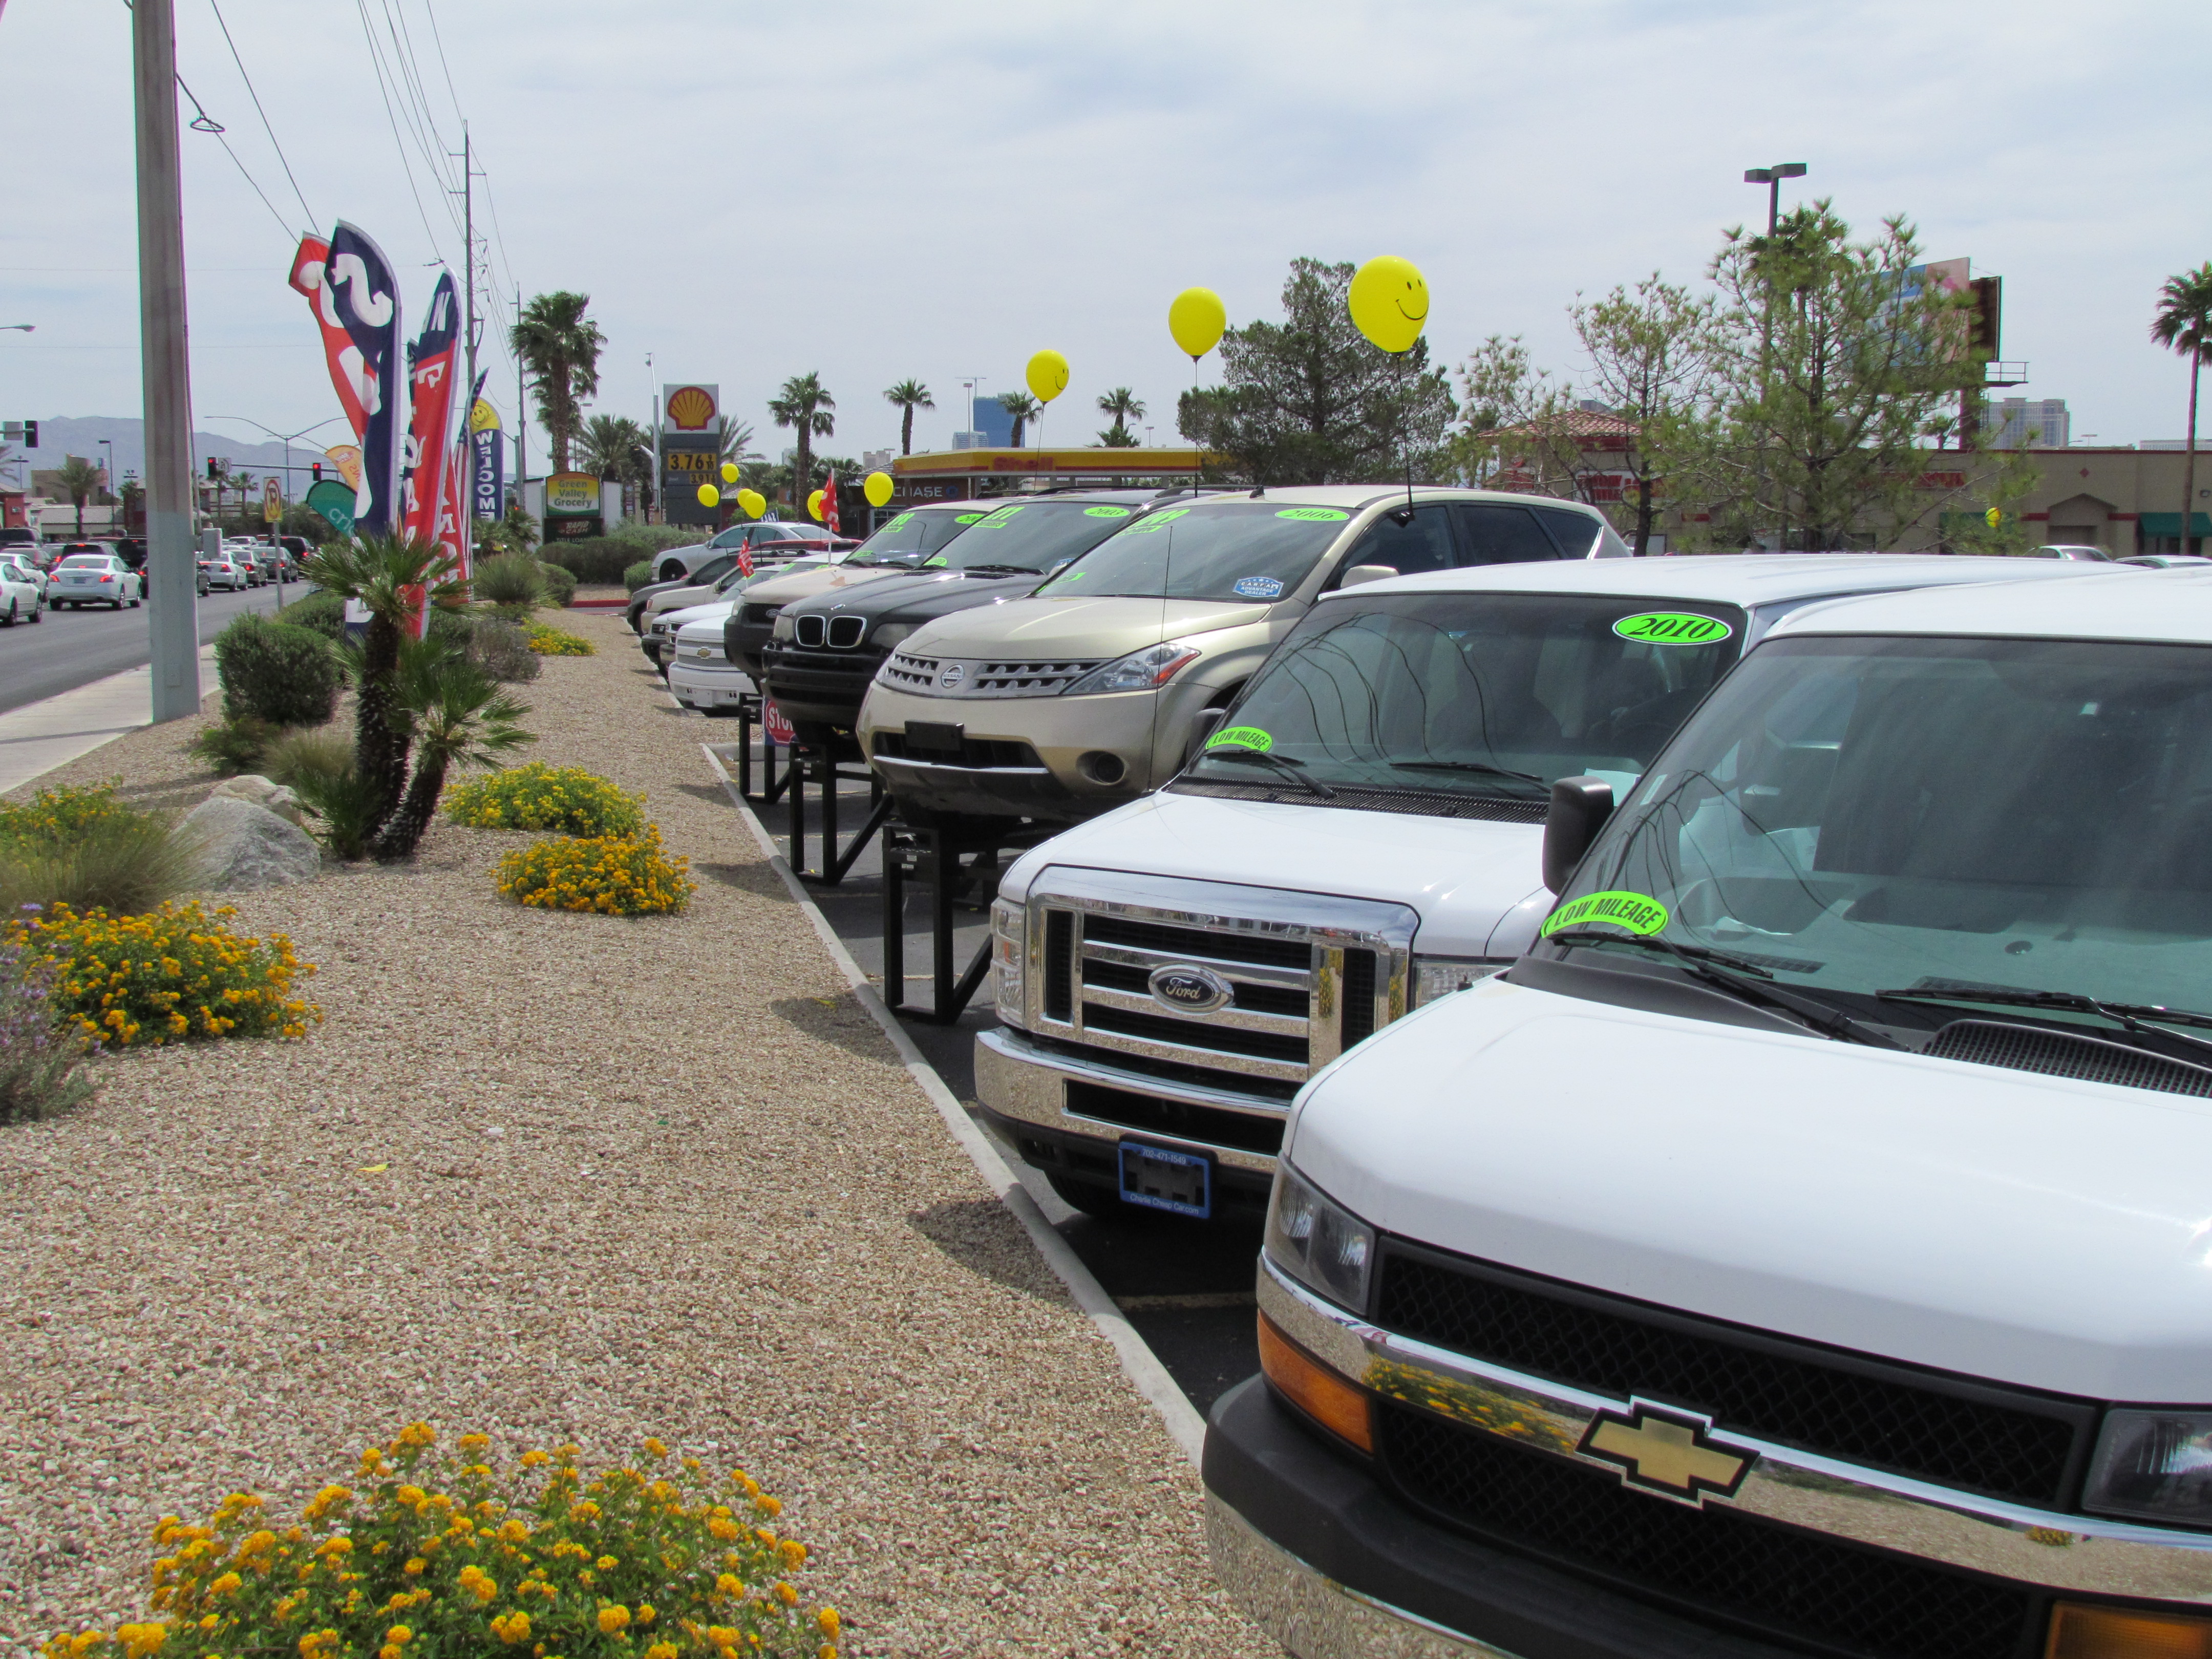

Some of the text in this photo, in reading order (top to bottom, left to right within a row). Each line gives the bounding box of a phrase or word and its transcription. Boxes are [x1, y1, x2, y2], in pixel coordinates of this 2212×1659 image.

[993, 456, 1053, 472] Shell
[558, 480, 587, 488] Green
[892, 486, 943, 497] CHASE
[559, 489, 587, 499] Valley
[554, 498, 592, 508] Grocery
[1282, 510, 1335, 519] 2006
[566, 520, 589, 529] RAPID
[1627, 618, 1716, 639] 2010
[769, 707, 794, 731] STO
[1213, 731, 1269, 749] LOW MILEAGE
[1554, 898, 1661, 929] LOW MILEAGE
[1166, 977, 1201, 999] Ford
[1142, 1148, 1186, 1164] 702-471-1549
[1130, 1194, 1199, 1215] Charlie Cheap Car.com
